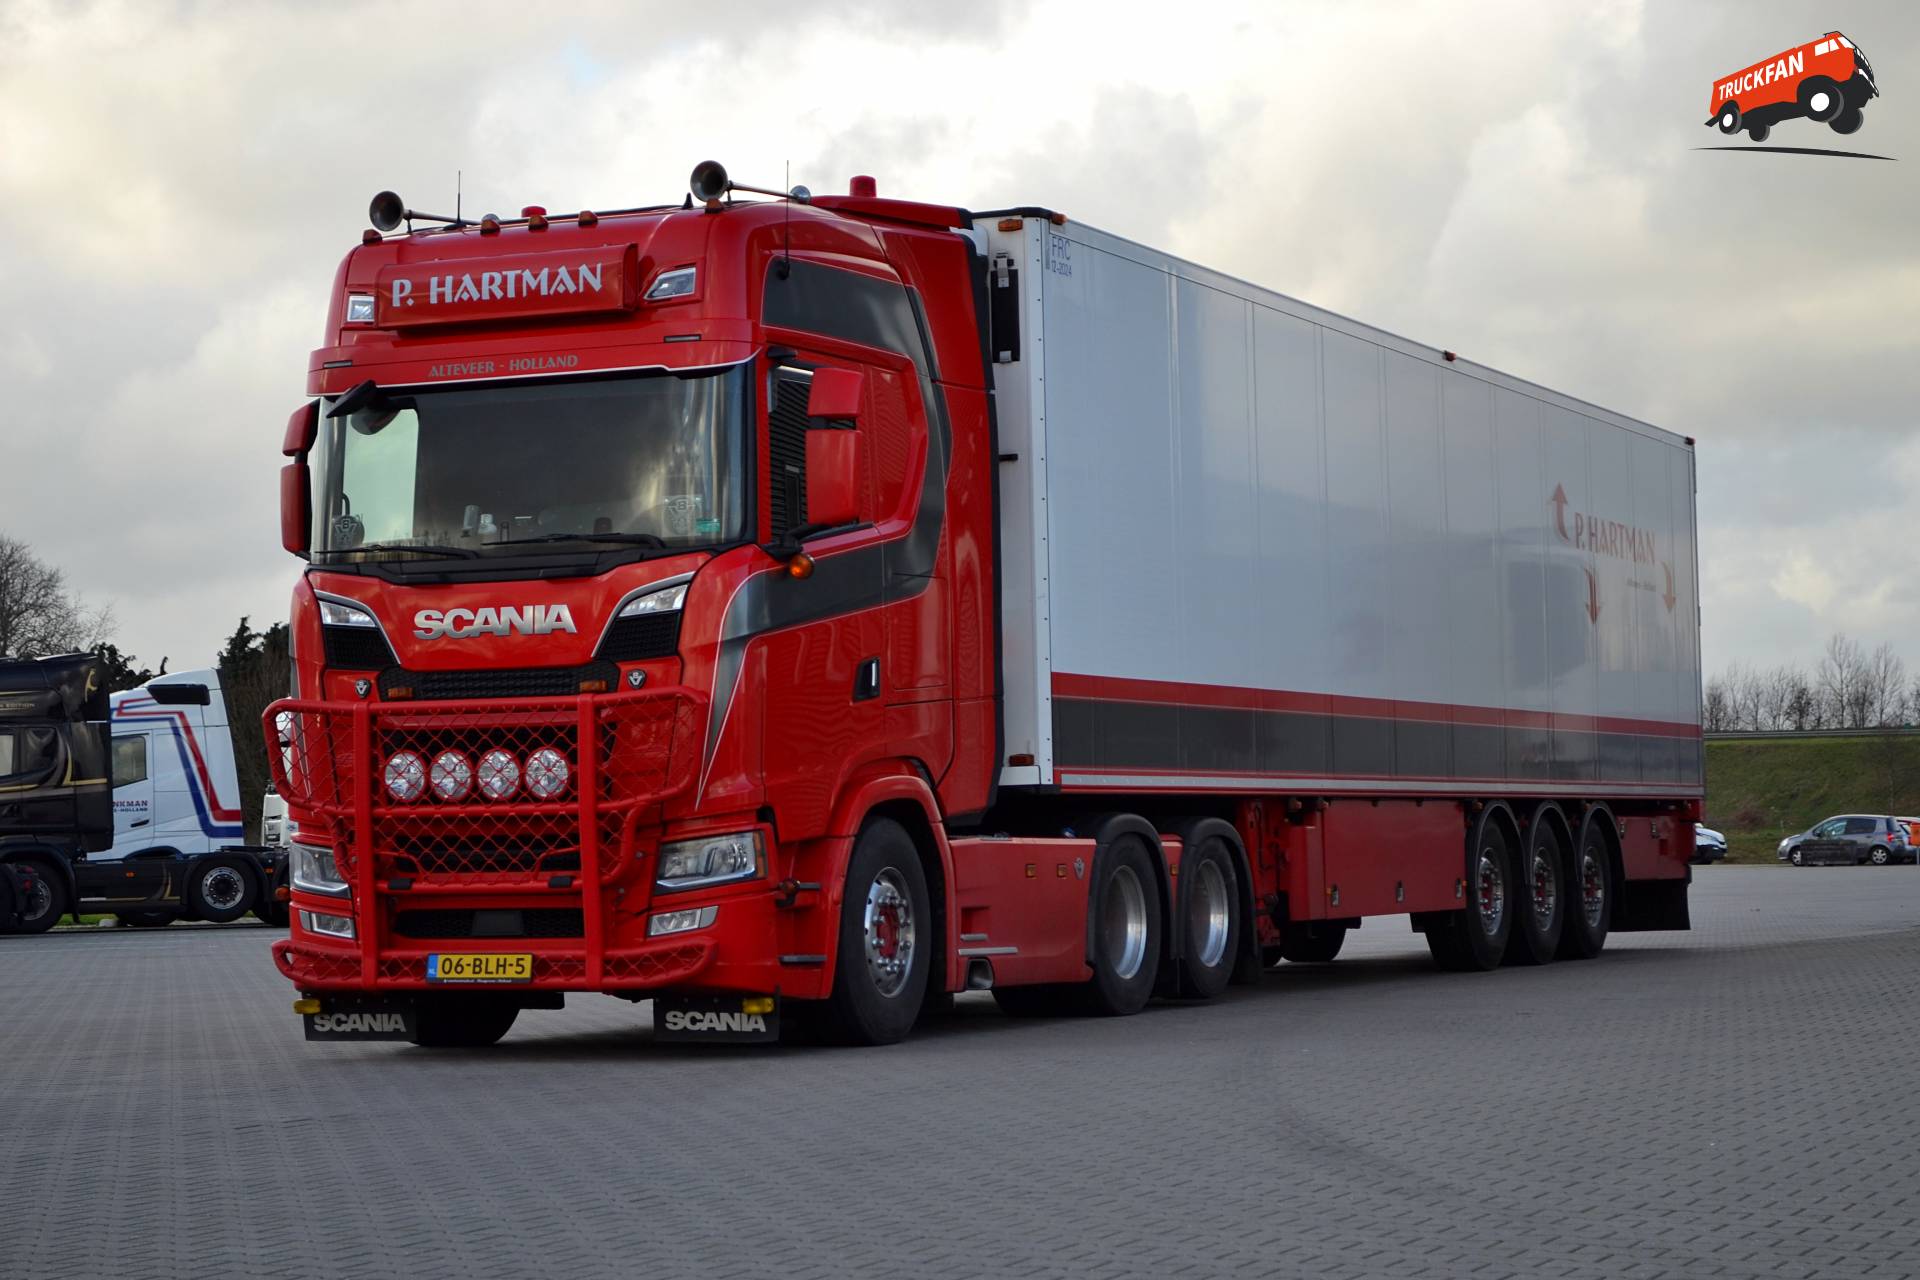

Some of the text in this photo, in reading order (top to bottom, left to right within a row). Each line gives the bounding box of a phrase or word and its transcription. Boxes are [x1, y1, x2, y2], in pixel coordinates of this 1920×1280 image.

[1051, 236, 1071, 260] FRC
[392, 263, 602, 307] P. HARTMAN
[428, 361, 495, 377] ALTEVEER
[509, 355, 578, 371] HOLLAND
[1574, 512, 1655, 566] P. HARTMAN
[412, 603, 577, 640] SCANIA
[441, 957, 526, 975] 06-BLH-5
[312, 1012, 407, 1033] SCANIA
[664, 1010, 767, 1033] SCANIA
